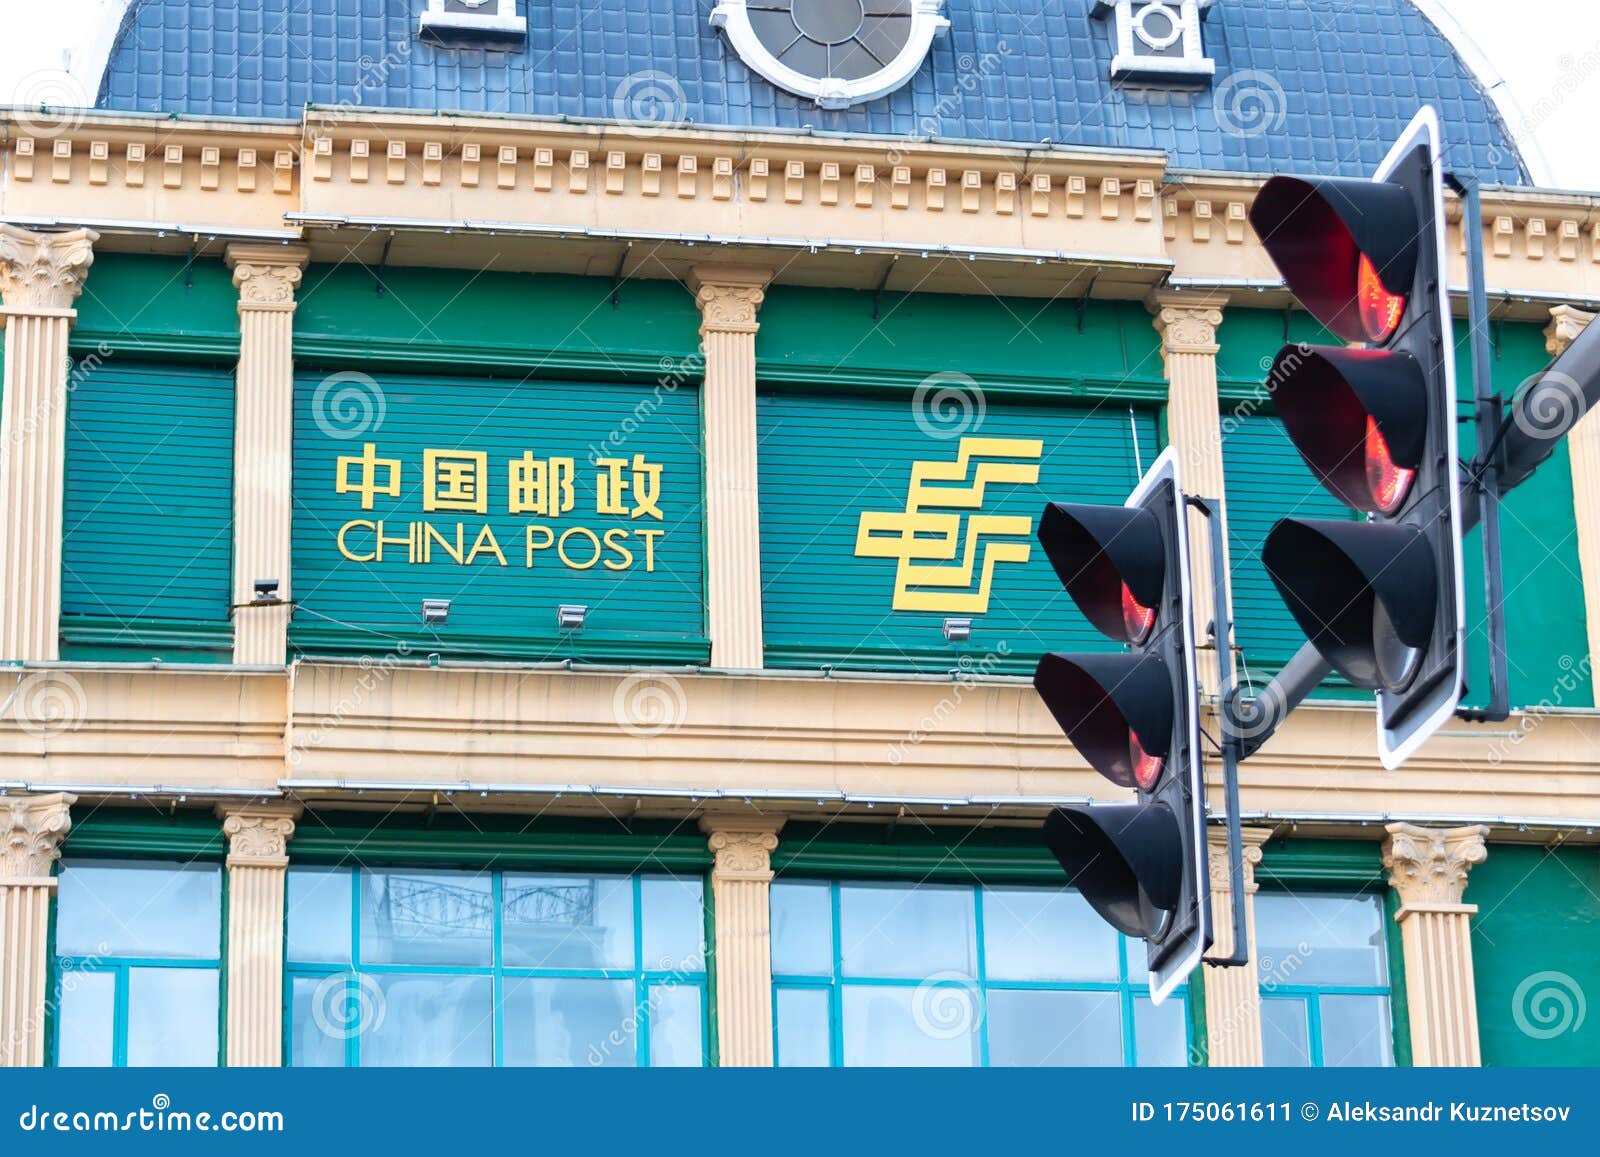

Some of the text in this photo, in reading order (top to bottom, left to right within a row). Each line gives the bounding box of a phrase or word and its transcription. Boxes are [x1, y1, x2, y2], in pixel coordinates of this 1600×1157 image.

[335, 442, 663, 520] 中国邮政
[337, 519, 665, 572] CHINA POST
